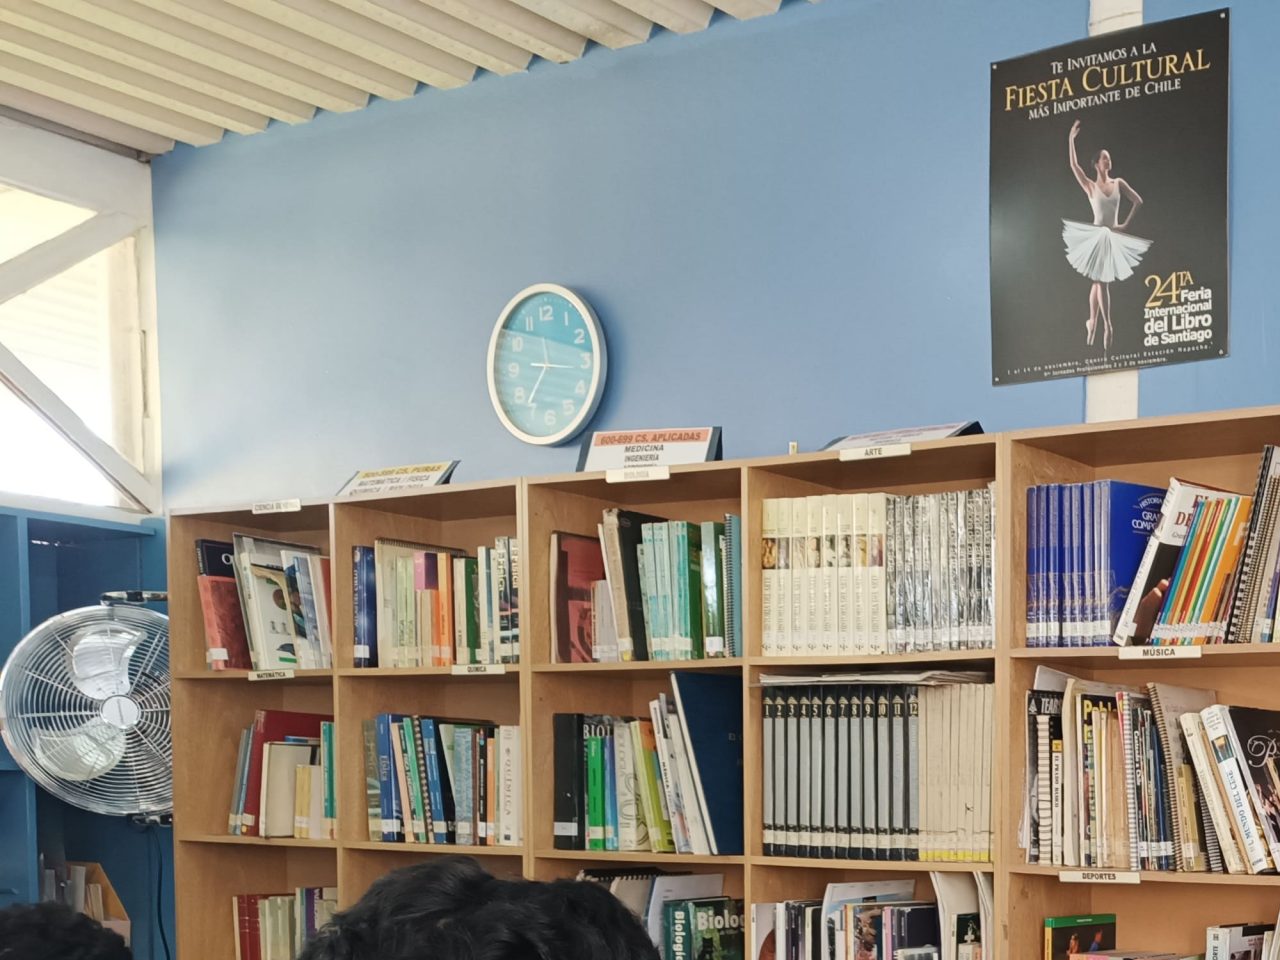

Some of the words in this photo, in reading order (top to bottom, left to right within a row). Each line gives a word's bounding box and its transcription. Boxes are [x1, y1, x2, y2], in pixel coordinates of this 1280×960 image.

[1051, 61, 1063, 75] TE
[1067, 47, 1127, 71] INVITAMOS
[1131, 46, 1138, 56] A
[1143, 41, 1157, 54] LA
[1004, 77, 1074, 111] FIESTA
[1082, 48, 1211, 92] CULTURAL
[1028, 104, 1050, 120] MÁS
[1053, 89, 1121, 115] IMPORTANTE
[1125, 86, 1141, 99] DE
[1144, 78, 1181, 95] CHILE
[1181, 286, 1212, 302] Feria
[539, 305, 554, 321] 12
[1144, 299, 1212, 318] Internacional
[526, 316, 534, 331] 11
[564, 311, 569, 326] 1
[1144, 316, 1168, 334] del
[1172, 314, 1212, 330] Libro
[574, 329, 585, 344] 2
[1144, 334, 1159, 347] de
[1161, 329, 1212, 344] Santiago
[512, 337, 524, 352] 10
[580, 352, 591, 369] 3
[508, 362, 520, 378] 9
[575, 379, 586, 395] 4
[514, 387, 525, 403] 8
[527, 402, 537, 420] 7
[562, 399, 575, 415] 5
[544, 410, 556, 426] 6
[651, 431, 702, 442] APLICADAS
[624, 444, 664, 452] MEDICINA
[864, 447, 883, 456] ARTE
[1142, 646, 1176, 656] MÚSICA
[765, 704, 770, 715] 1
[776, 704, 782, 715] 2
[788, 704, 794, 715] 3
[801, 704, 807, 715] 4
[812, 704, 818, 715] 5
[826, 704, 832, 715] 6
[840, 704, 845, 715] 7
[852, 704, 857, 715] 8
[865, 704, 871, 715] 9
[878, 704, 886, 715] 10
[894, 704, 901, 715] 11
[909, 704, 918, 715] 12
[1082, 872, 1116, 880] DEPORTES
